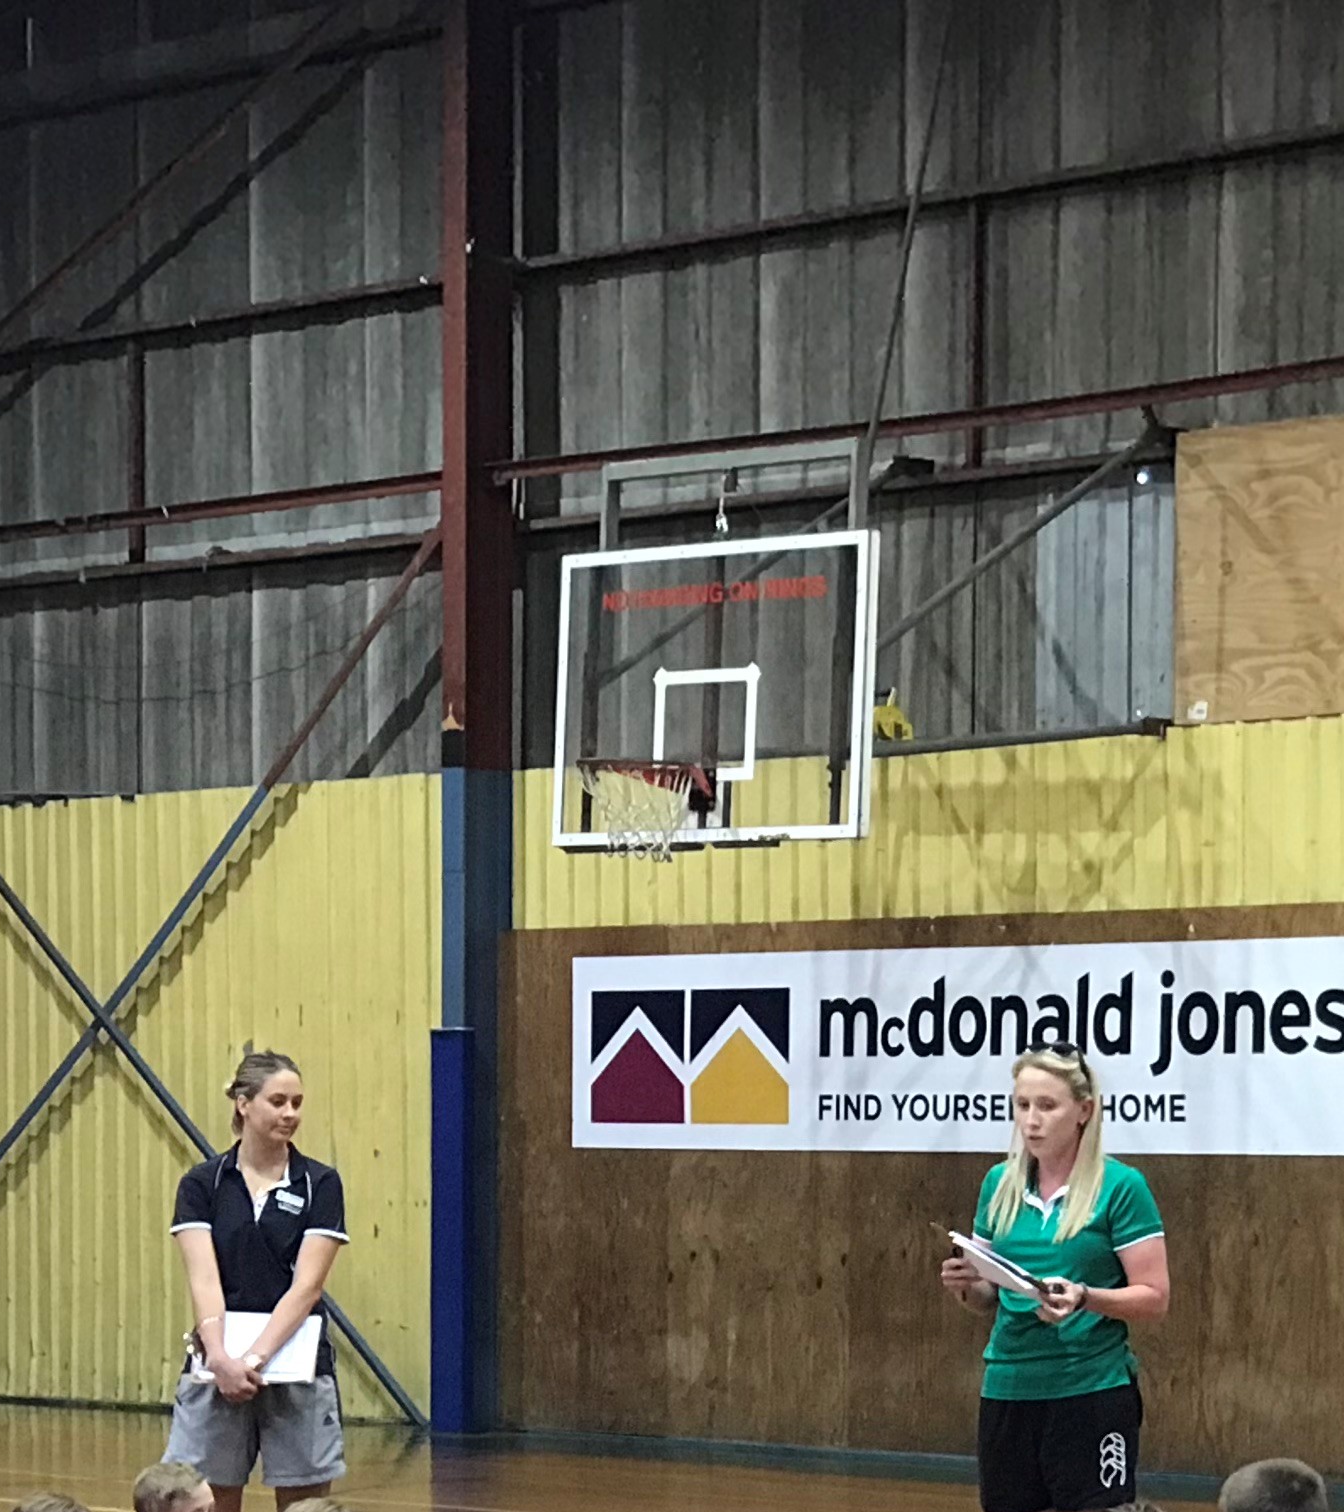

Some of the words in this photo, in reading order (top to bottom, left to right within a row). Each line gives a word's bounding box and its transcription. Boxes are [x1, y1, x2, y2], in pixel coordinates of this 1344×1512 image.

[818, 1094, 882, 1122] FIND
[891, 1094, 1014, 1122] YOURSE
[1100, 1094, 1187, 1123] HOME
